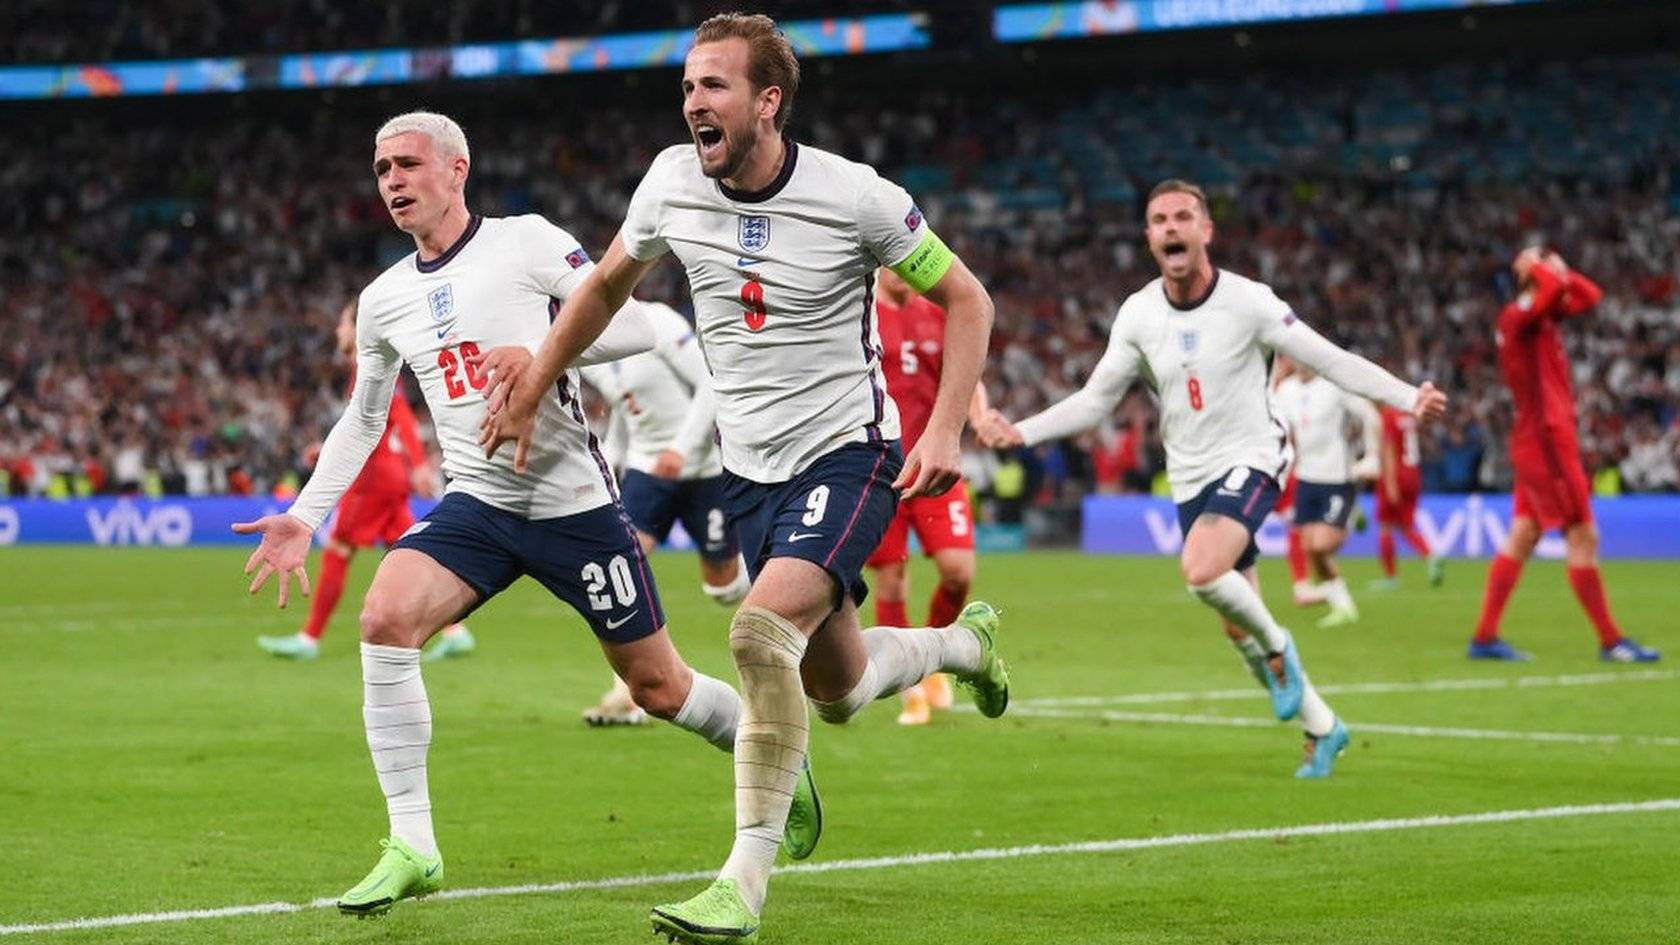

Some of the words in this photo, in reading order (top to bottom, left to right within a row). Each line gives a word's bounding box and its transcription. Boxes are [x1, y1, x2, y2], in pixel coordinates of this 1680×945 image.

[901, 338, 919, 375] 5
[1187, 377, 1203, 411] 8
[801, 484, 830, 527] 9
[948, 500, 969, 537] 5
[707, 508, 725, 541] 2
[581, 554, 637, 610] 20
